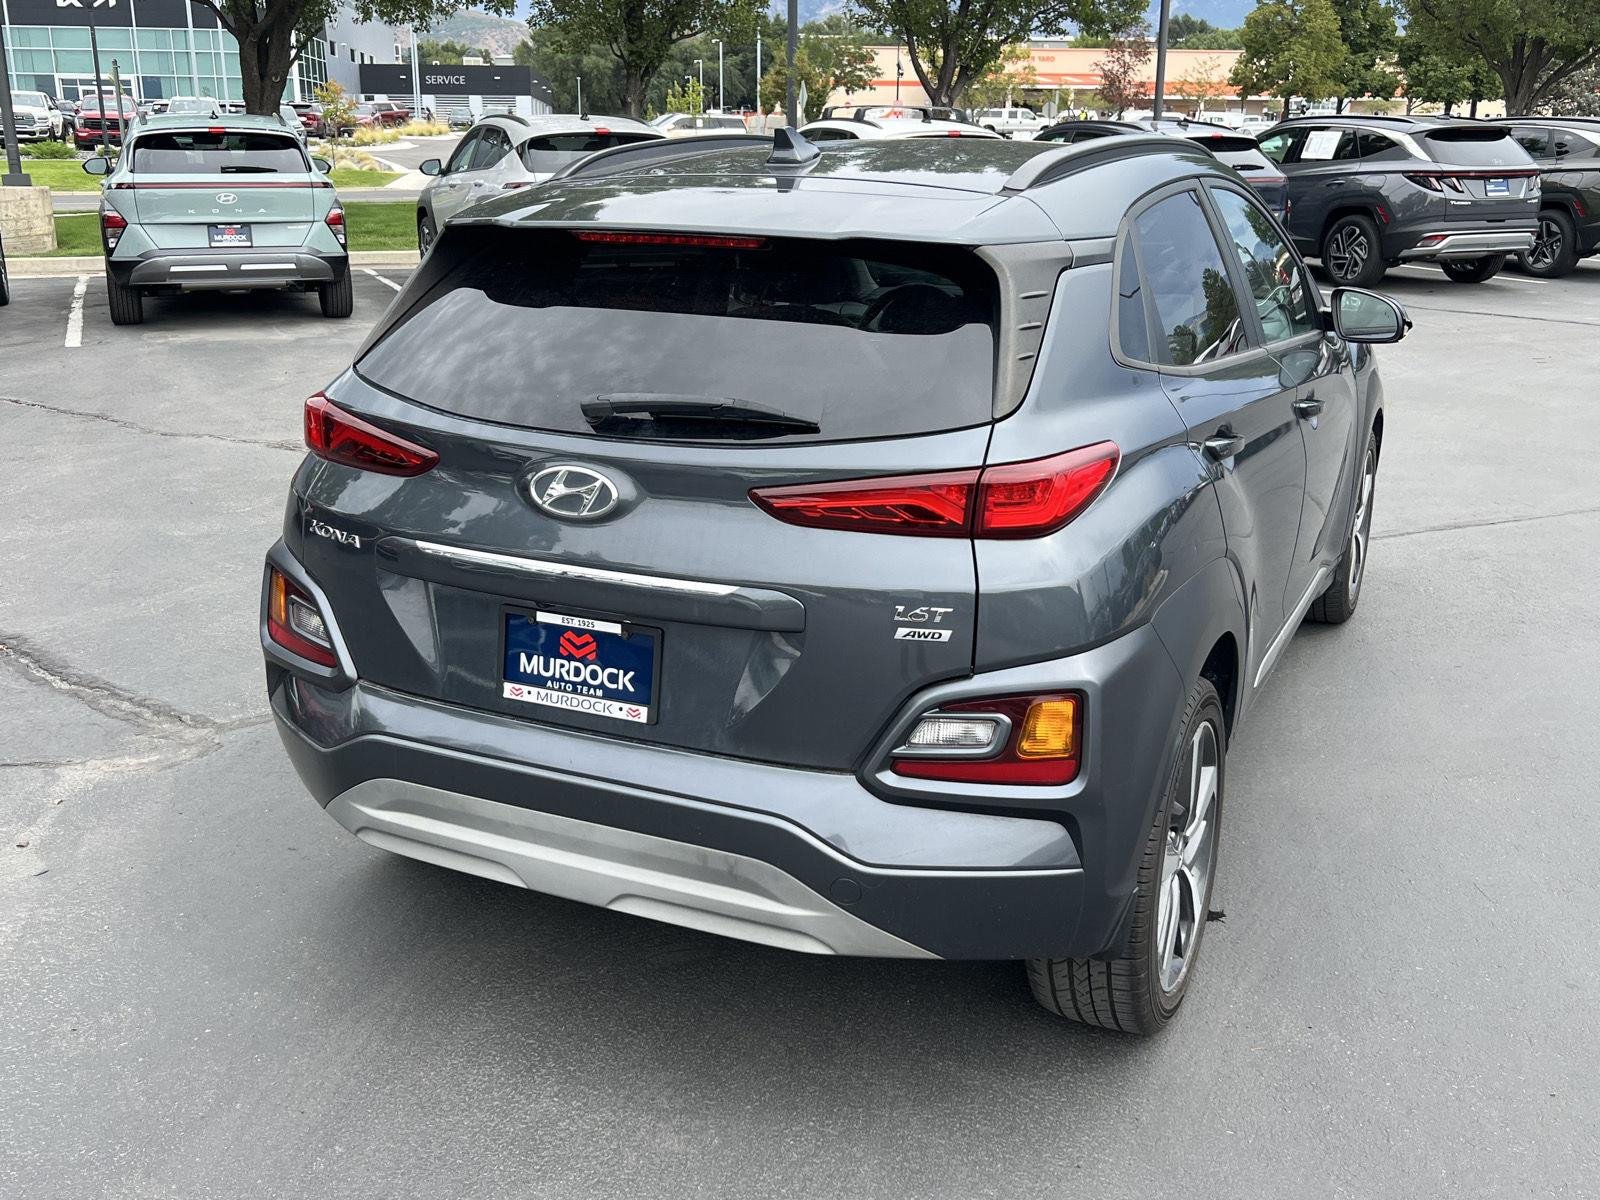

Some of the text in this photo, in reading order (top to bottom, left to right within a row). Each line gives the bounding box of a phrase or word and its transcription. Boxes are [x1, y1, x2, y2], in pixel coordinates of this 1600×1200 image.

[425, 75, 466, 85] SERVICE
[309, 519, 360, 549] KONA
[561, 617, 596, 629] EST. 1925
[902, 630, 943, 640] AWD
[519, 652, 635, 693] MURDOCK
[546, 680, 603, 697] AUTO TEAM
[536, 691, 613, 714] MURDOCK
